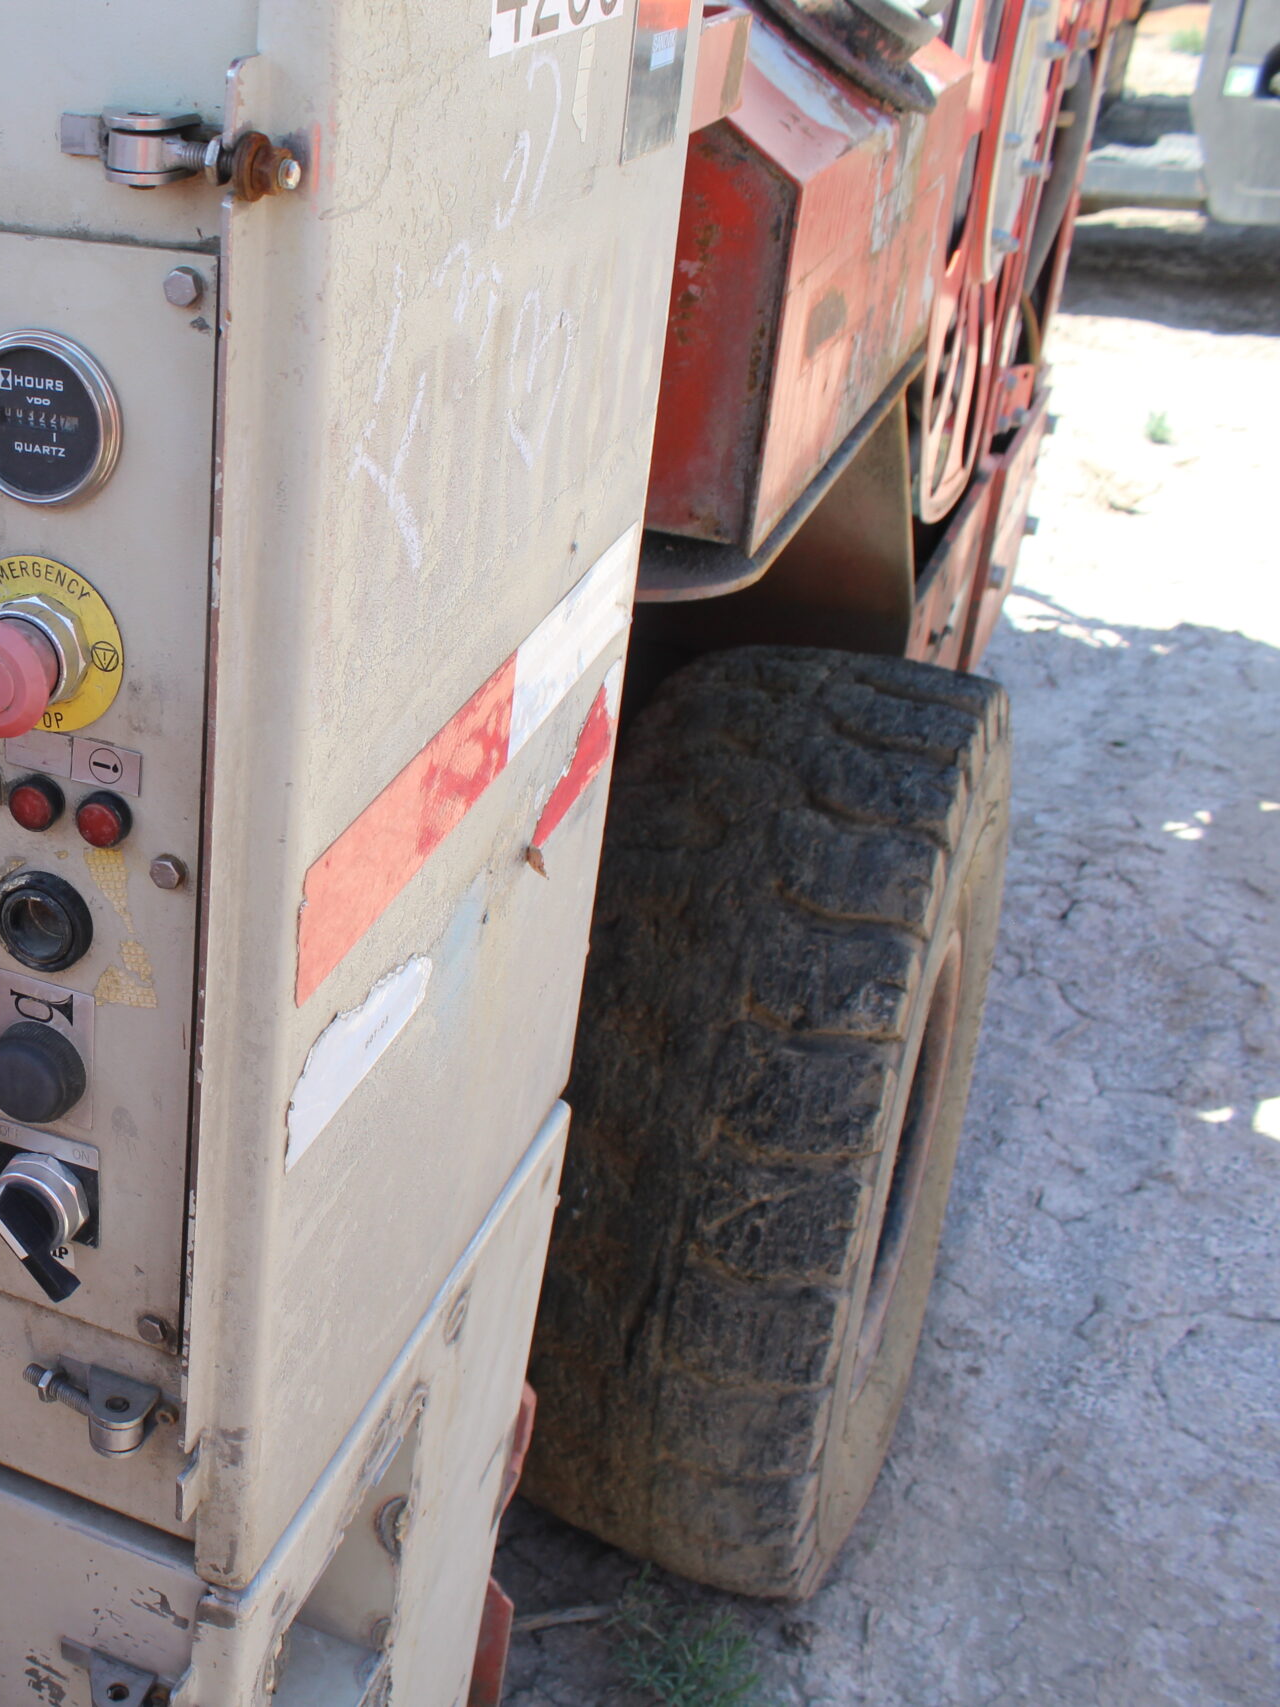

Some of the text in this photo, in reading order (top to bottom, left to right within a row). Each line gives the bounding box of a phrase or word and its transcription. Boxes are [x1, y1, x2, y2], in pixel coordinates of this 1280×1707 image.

[14, 374, 64, 392] HOURS
[26, 396, 51, 406] VDO
[14, 441, 66, 458] QUARTZ
[42, 711, 65, 729] OP
[72, 1148, 90, 1164] ON
